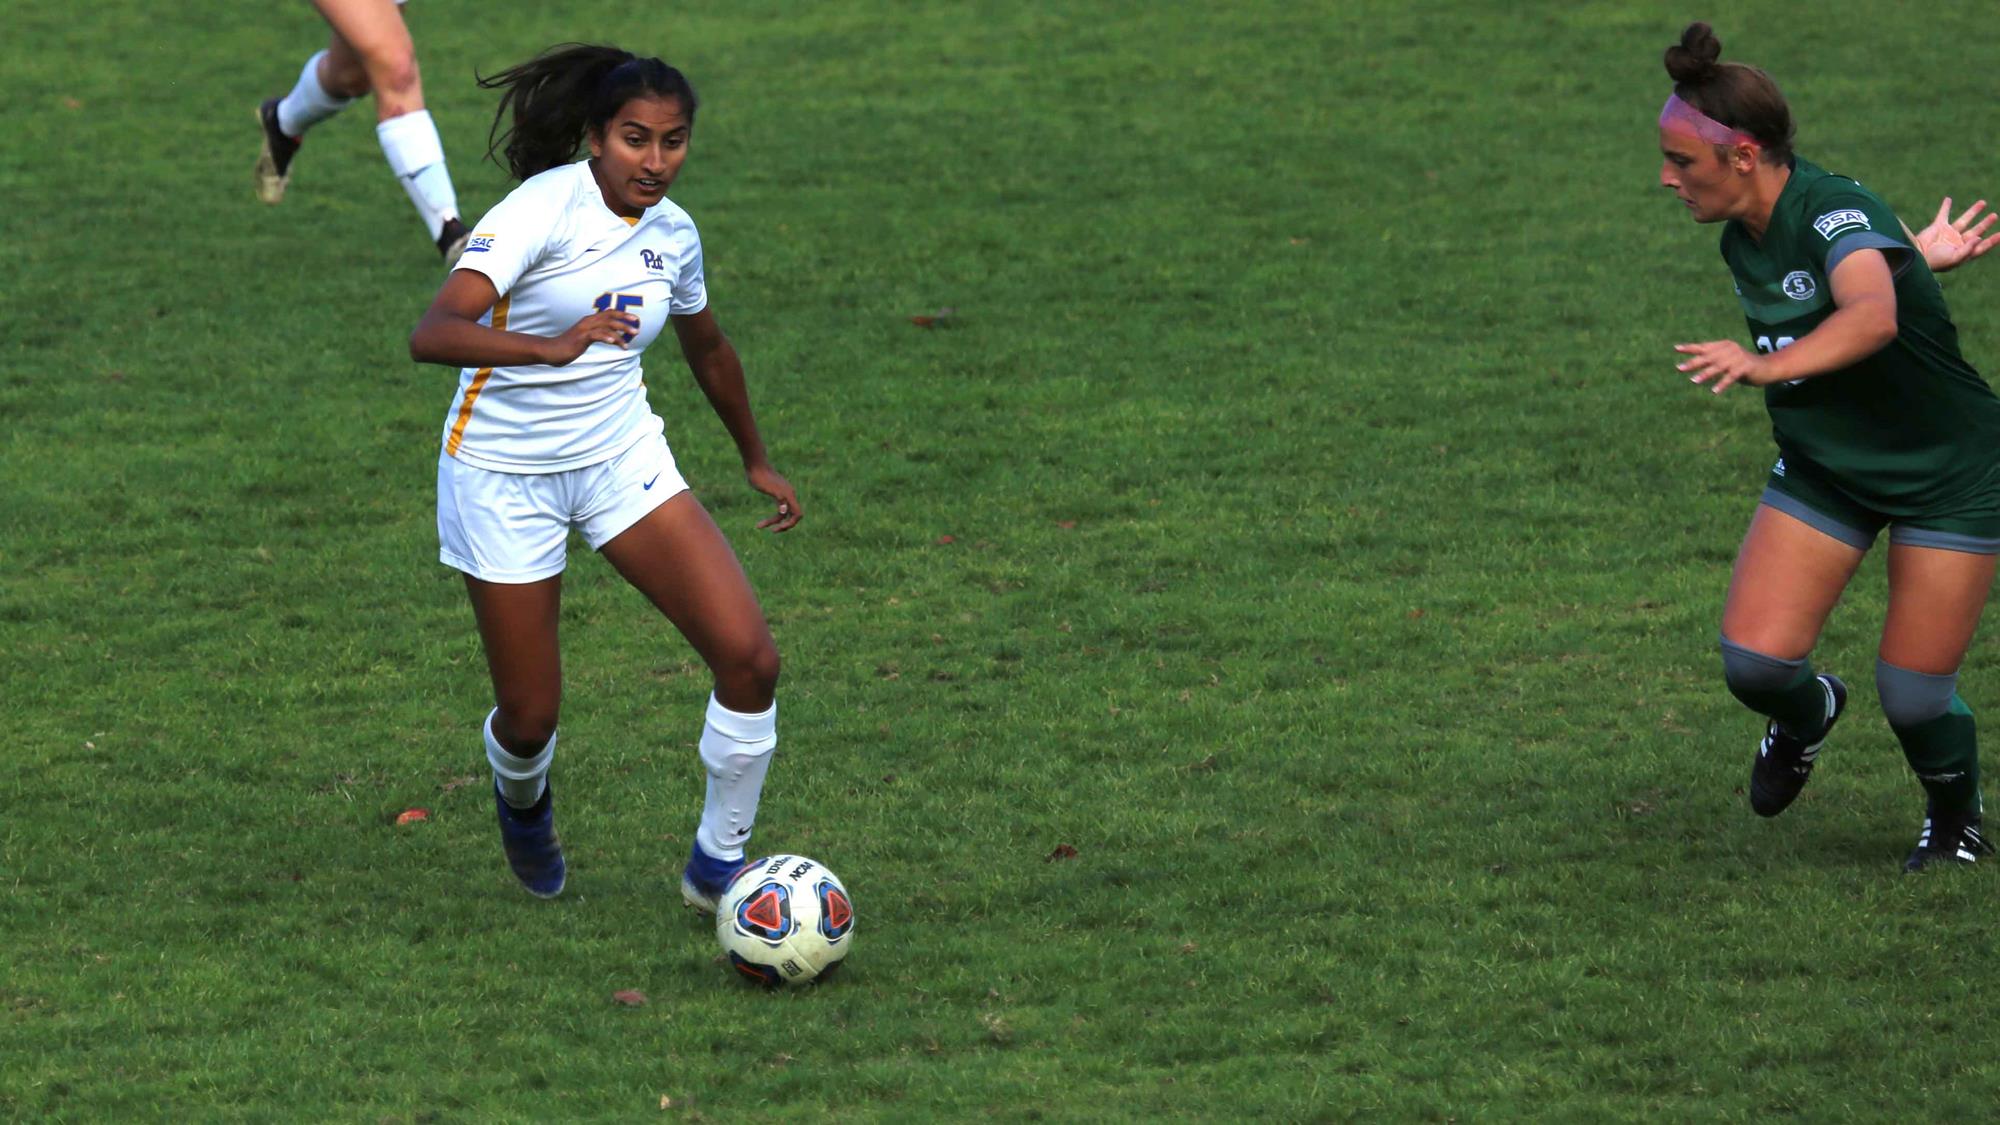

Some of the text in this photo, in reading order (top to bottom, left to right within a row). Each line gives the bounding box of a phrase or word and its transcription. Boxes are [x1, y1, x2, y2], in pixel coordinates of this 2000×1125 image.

[640, 249, 664, 270] Pitt
[1793, 278, 1806, 293] S
[789, 862, 814, 881] NCAA
